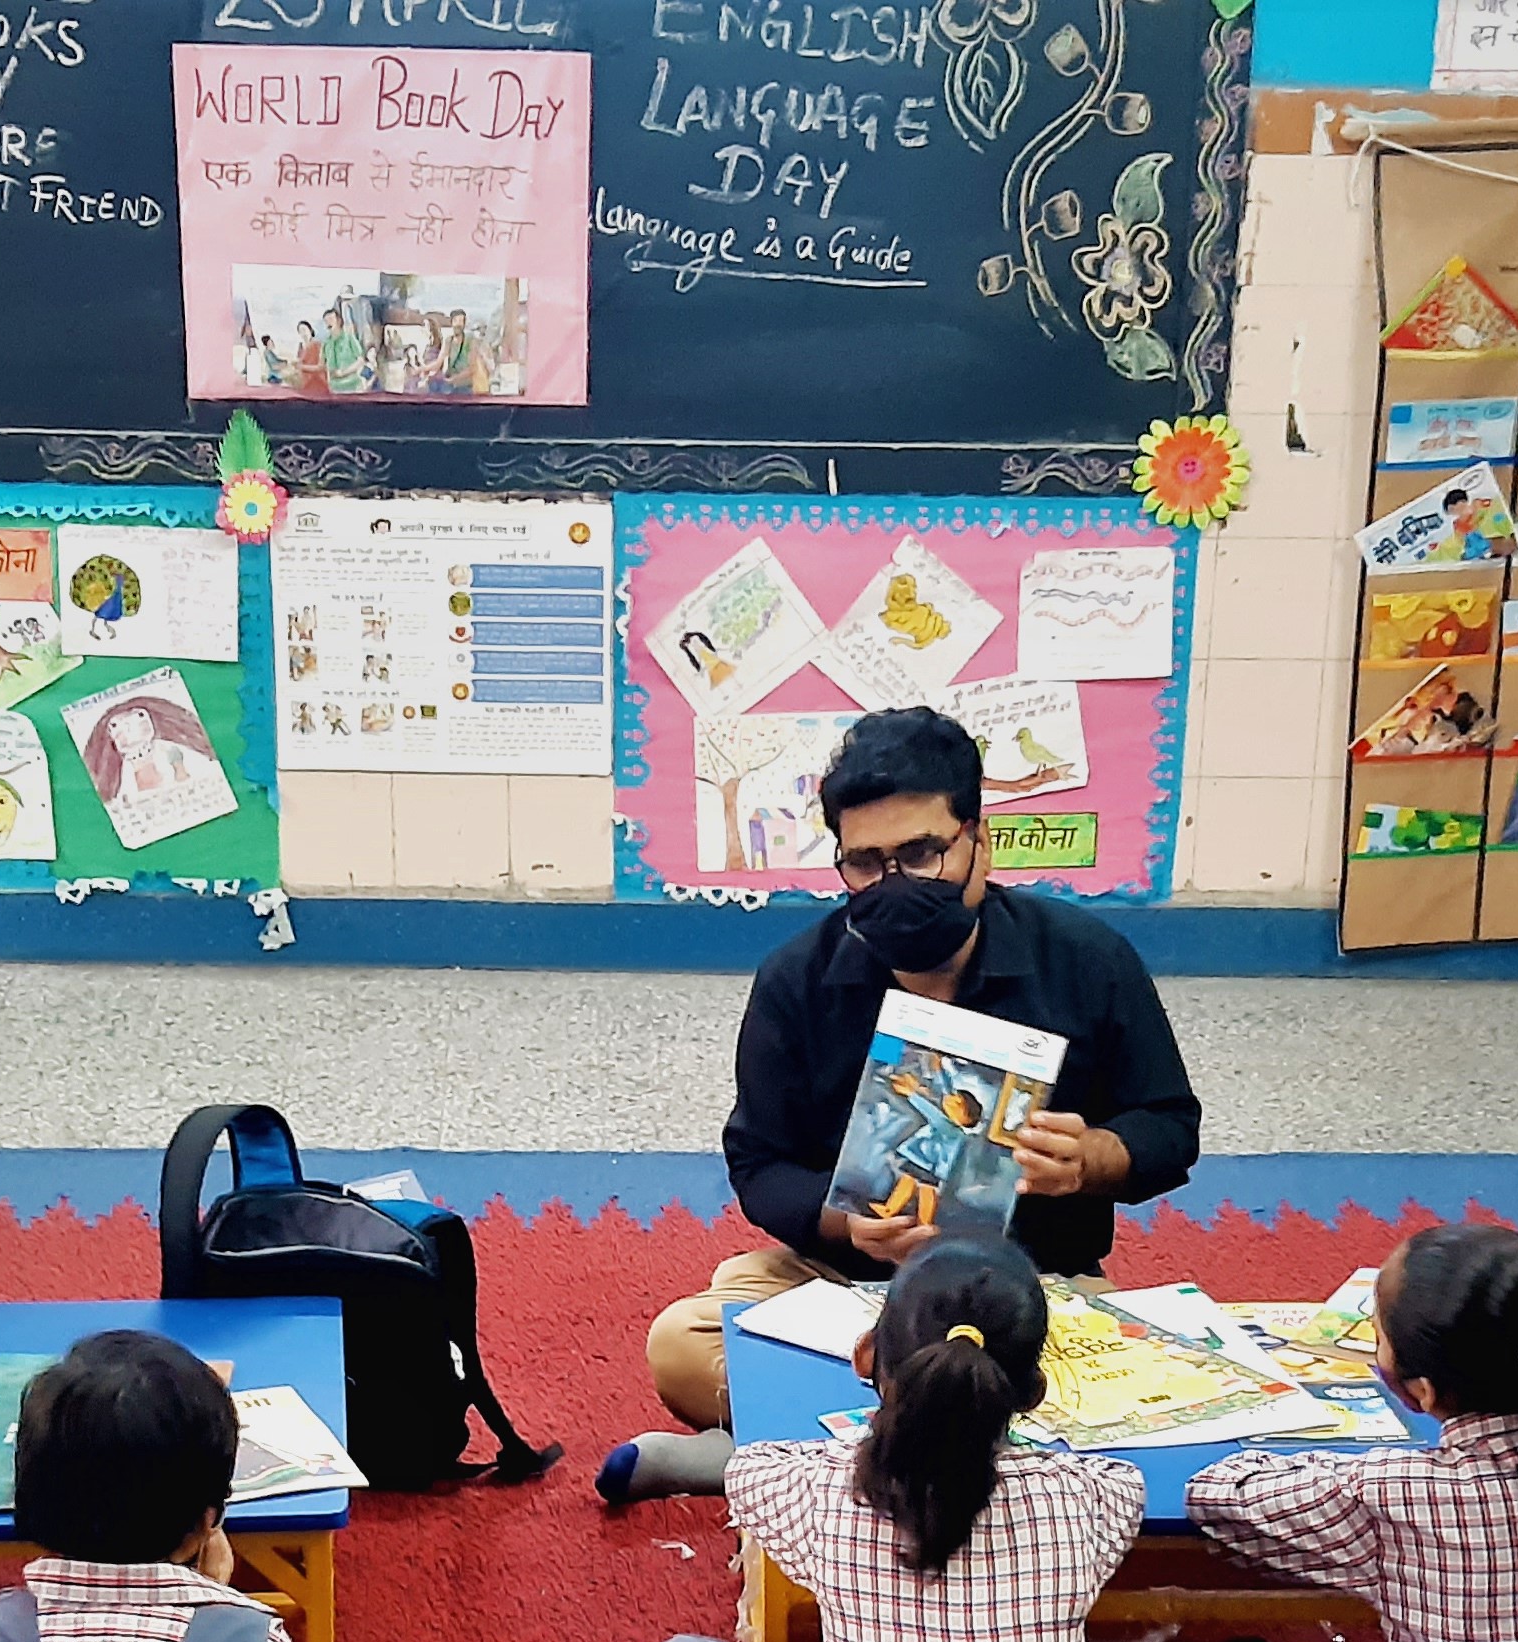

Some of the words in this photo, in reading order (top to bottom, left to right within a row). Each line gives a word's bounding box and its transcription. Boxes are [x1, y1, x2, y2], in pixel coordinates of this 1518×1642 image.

[652, 0, 933, 67] ENGLISH
[641, 57, 936, 151] LANGUAGE
[29, 173, 161, 227] FRIEND
[201, 160, 252, 190] एक
[274, 154, 352, 187] किताब
[370, 150, 395, 187] से
[410, 152, 528, 200] ईमानदार
[688, 143, 849, 219] DAY
[250, 198, 307, 245] कोई
[326, 205, 385, 239] मित्र
[473, 211, 536, 249] होता
[595, 188, 744, 293] Language
[755, 217, 781, 259] is
[796, 236, 819, 262] a
[829, 228, 911, 274] Guide
[1018, 818, 1078, 854] कोना
